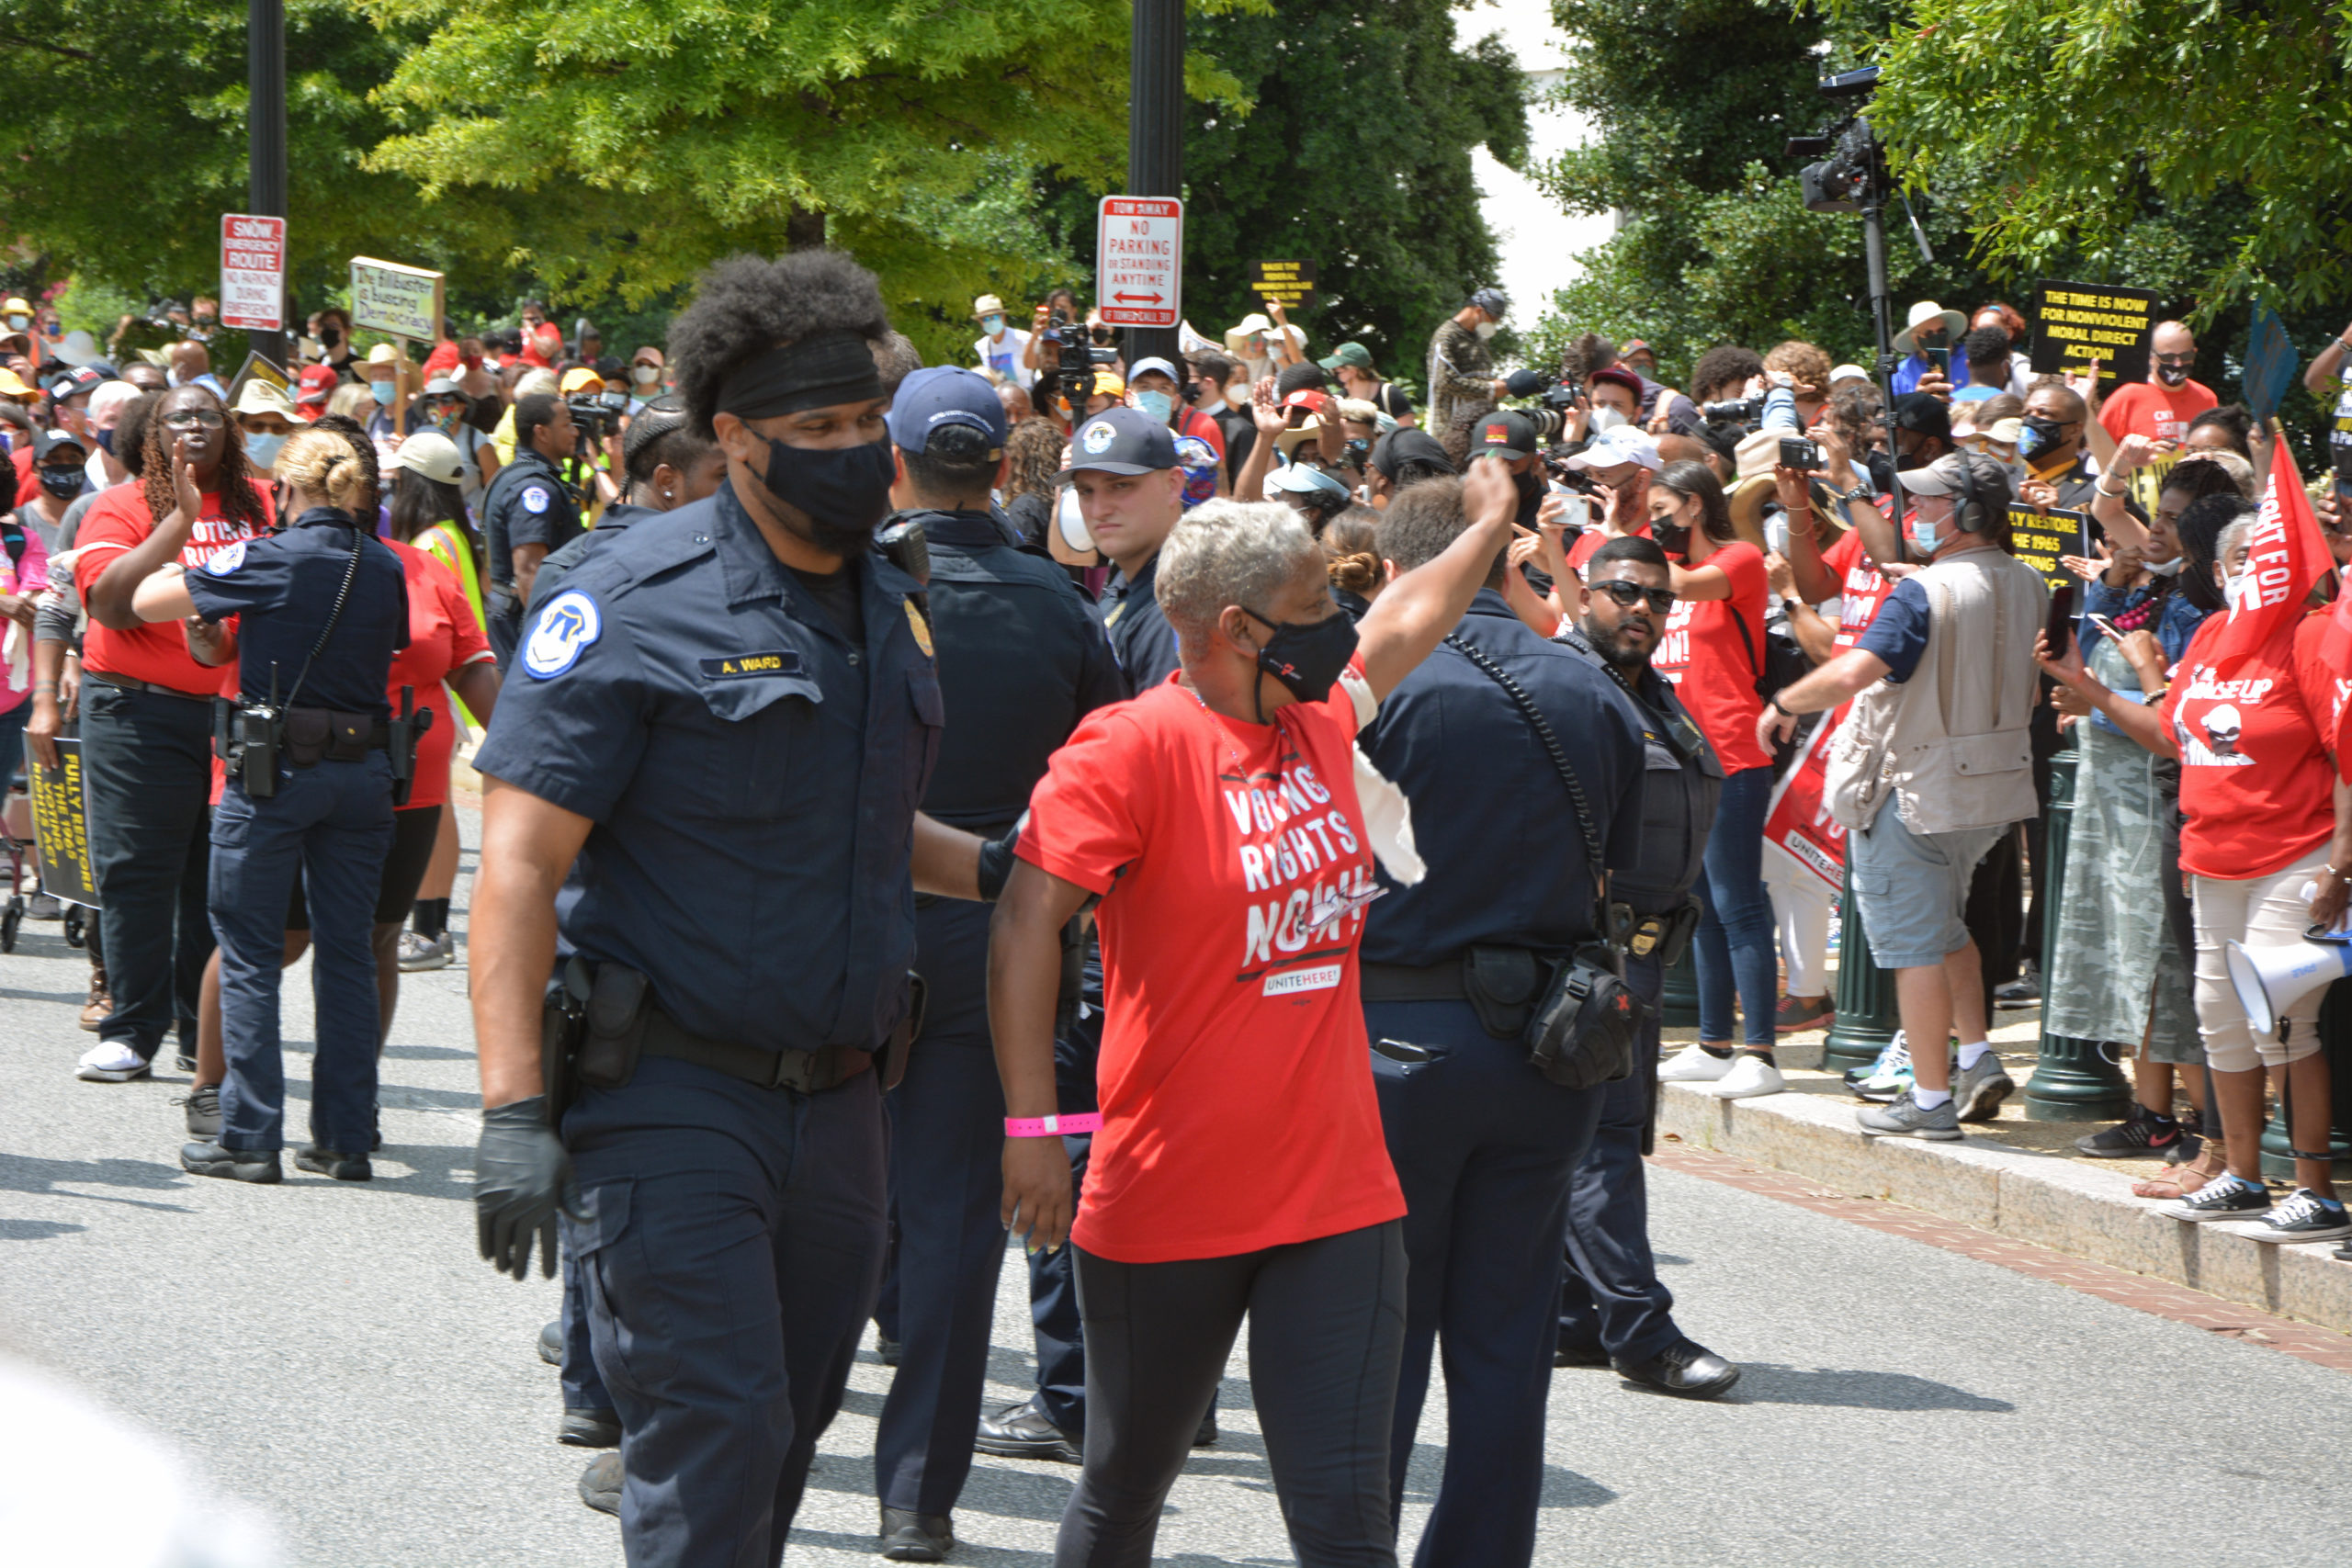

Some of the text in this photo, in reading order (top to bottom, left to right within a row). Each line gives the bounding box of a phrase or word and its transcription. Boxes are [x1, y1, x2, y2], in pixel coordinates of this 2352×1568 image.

[232, 221, 275, 238] SNOW
[1130, 220, 1149, 235] NO
[225, 238, 279, 253] EMERGENCY
[1109, 238, 1170, 255] PARKING
[228, 252, 277, 269] ROUTE
[1120, 258, 1170, 271] STANDING
[227, 271, 279, 287] NO PARKING
[356, 266, 376, 284] The
[1112, 273, 1165, 287] ANYTIME
[235, 287, 268, 300] DURING
[2044, 290, 2148, 312] THE TIME IS NOW
[226, 301, 277, 316] EMERGENCY
[359, 300, 434, 335] Democracy
[2041, 307, 2149, 330] FOR NONVIOLENT
[2047, 324, 2138, 346] MORAL DIRECT
[2064, 344, 2115, 360] ACTION
[192, 520, 254, 543] OTING
[2026, 513, 2078, 534] RESTORE
[2012, 532, 2061, 552] HE 1965
[2014, 553, 2056, 572] TING
[2256, 549, 2290, 607] FOR
[722, 656, 782, 673] A. WARD
[2239, 679, 2273, 699] UP
[32, 762, 51, 827] RIGHTS
[42, 830, 58, 869] ACT
[43, 782, 64, 852] VOTING
[53, 782, 78, 860] THE 1965
[64, 754, 94, 893] FULLY RESTORE
[1239, 810, 1358, 892] RIGHTS
[1242, 864, 1363, 968] NOW!
